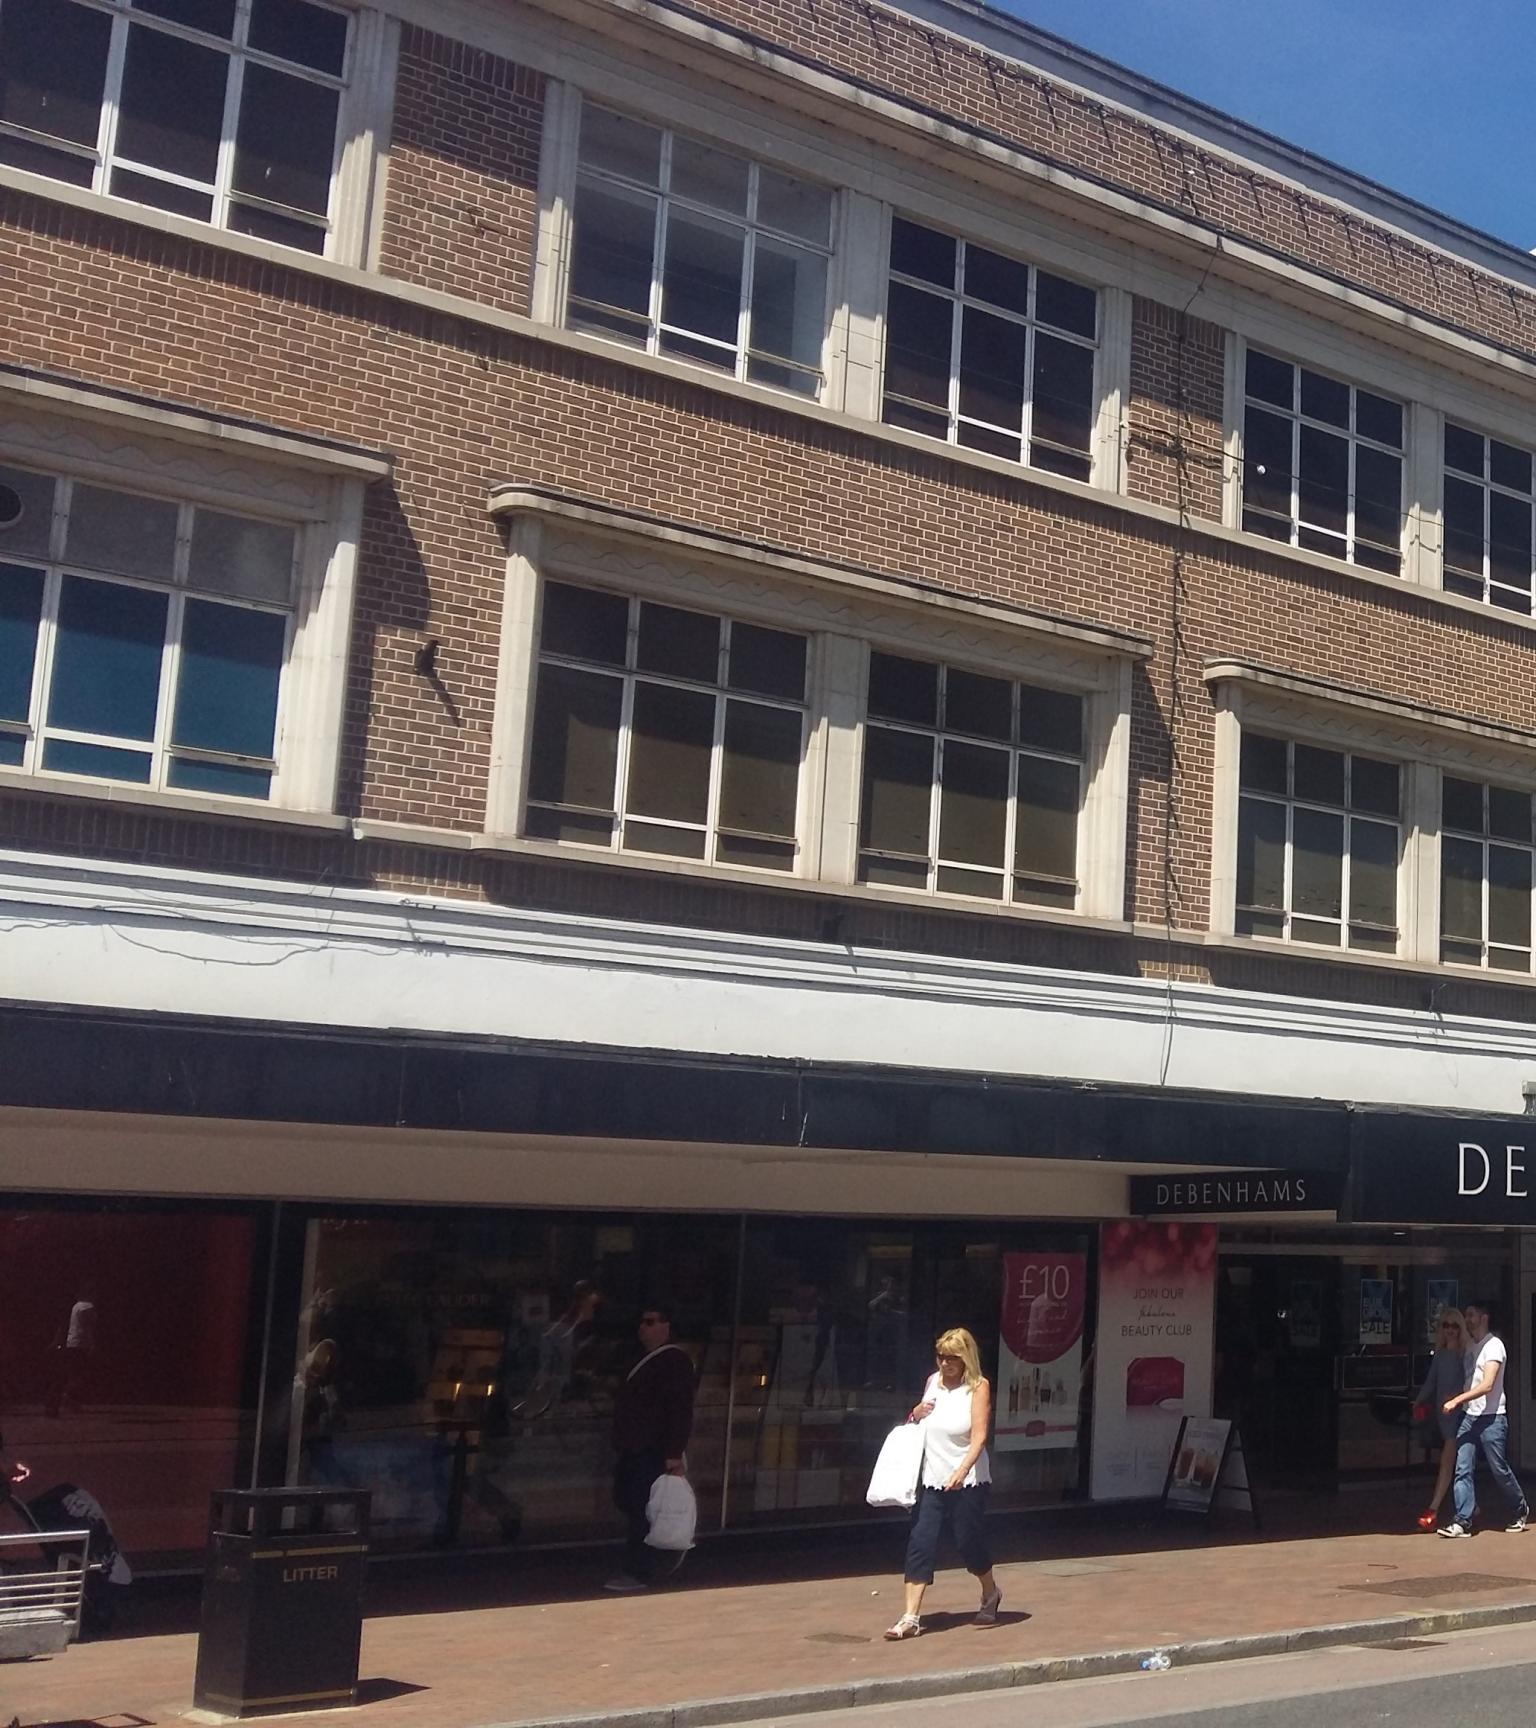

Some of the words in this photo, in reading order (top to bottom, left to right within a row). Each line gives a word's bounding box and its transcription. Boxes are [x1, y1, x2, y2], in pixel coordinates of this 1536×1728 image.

[1156, 1179, 1306, 1205] DEBENHAMS
[1018, 1265, 1071, 1300] £10
[1133, 1288, 1159, 1300] JOIN
[1161, 1287, 1184, 1300] OUR
[1121, 1325, 1164, 1337] BEAUTY
[1165, 1324, 1193, 1336] CLUB
[283, 1565, 338, 1583] LITTER
